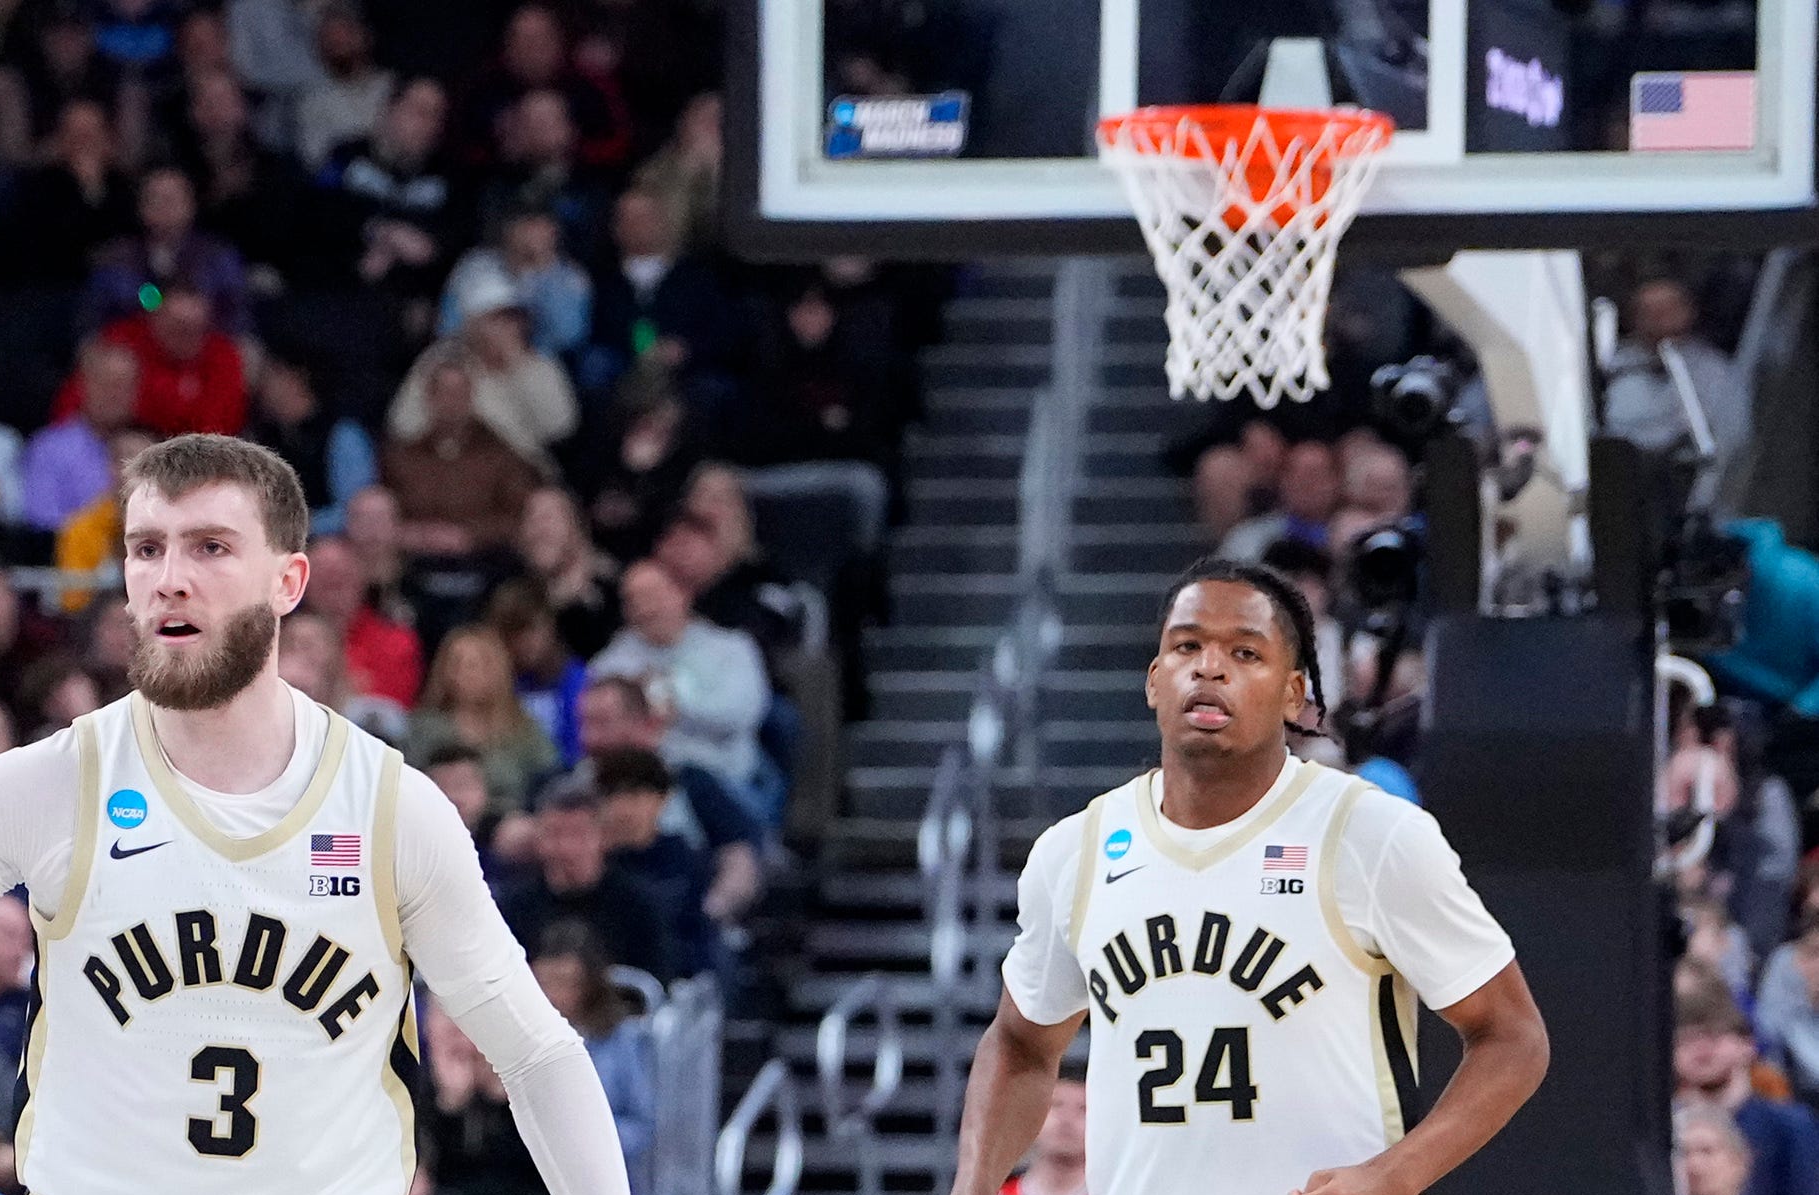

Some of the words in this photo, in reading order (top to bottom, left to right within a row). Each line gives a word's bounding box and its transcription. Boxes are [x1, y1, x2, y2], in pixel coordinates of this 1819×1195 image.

[111, 806, 145, 820] NCAA
[82, 906, 383, 1044] PURDUE
[1088, 909, 1326, 1027] PURDUE
[185, 1043, 262, 1160] 3
[1134, 1024, 1260, 1127] 24
